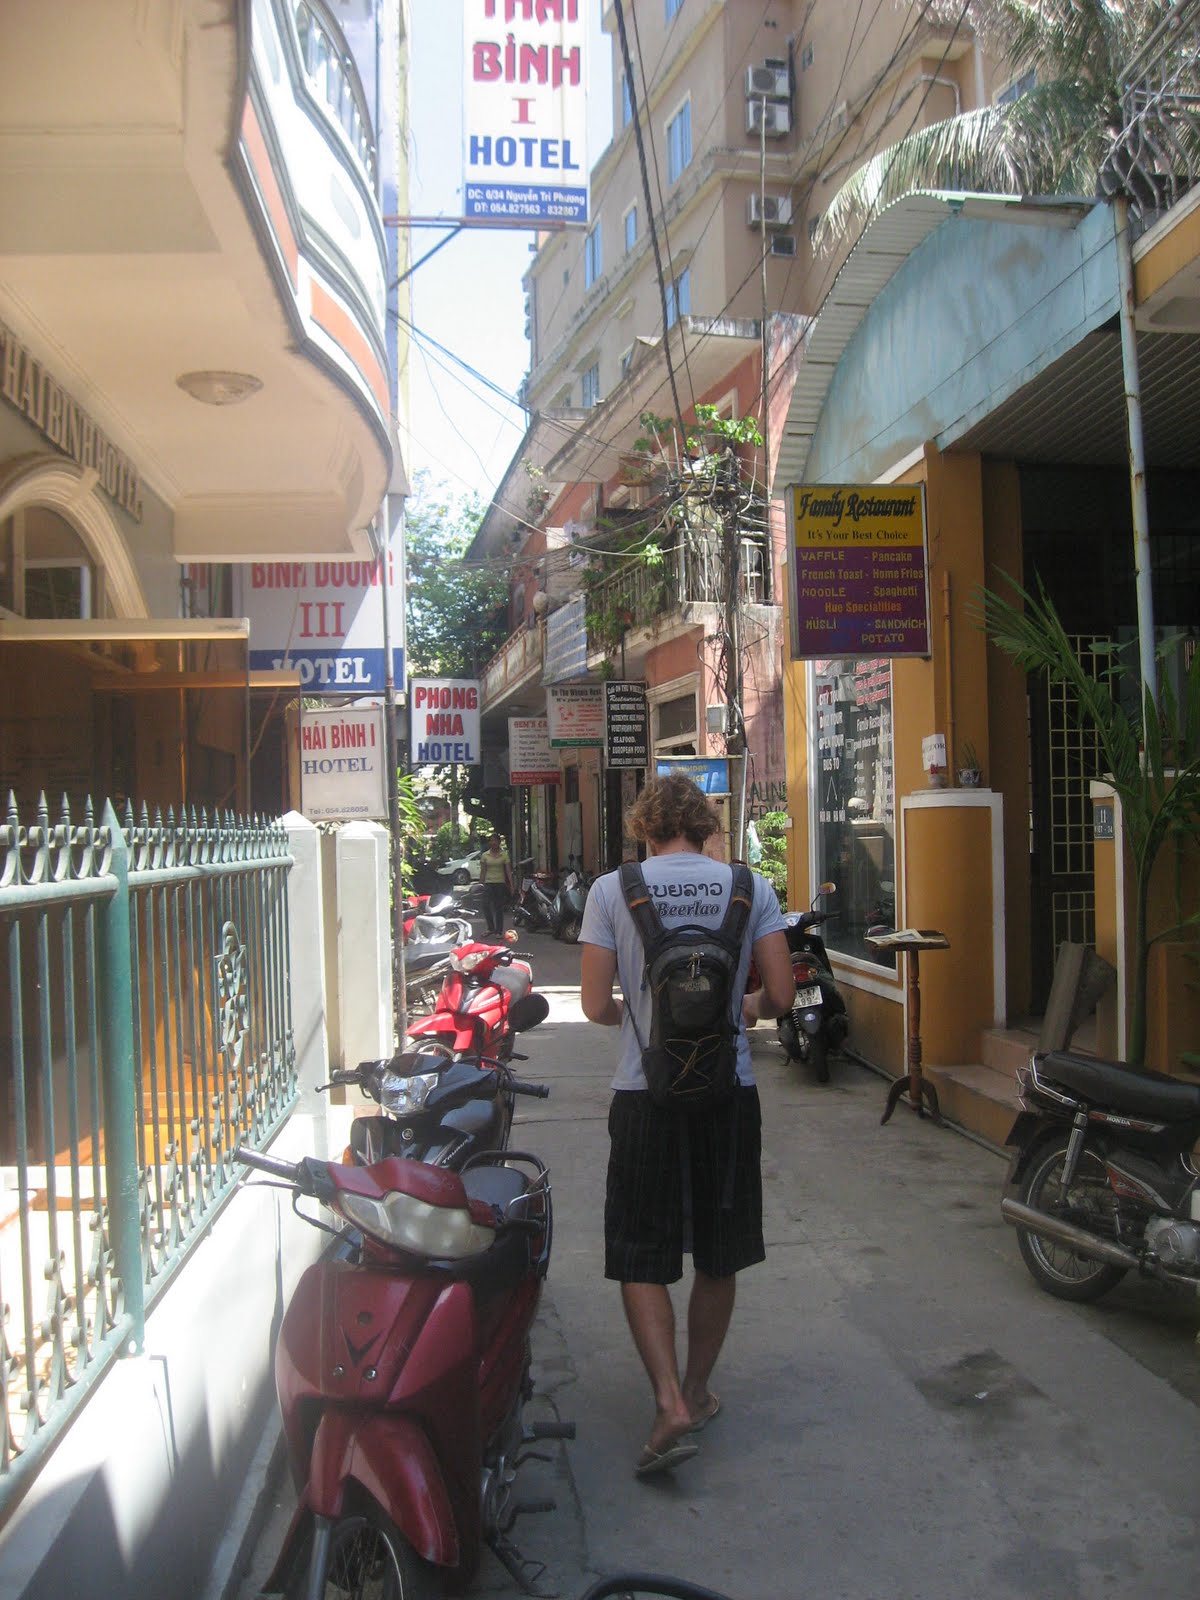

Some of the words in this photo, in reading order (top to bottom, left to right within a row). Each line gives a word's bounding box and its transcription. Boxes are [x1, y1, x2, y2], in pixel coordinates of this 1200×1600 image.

[511, 97, 536, 125] I
[469, 134, 580, 170] HOTEL
[798, 490, 845, 527] Family
[845, 493, 917, 522] Restaurant
[808, 529, 823, 540] It's
[826, 530, 849, 540] Your
[852, 530, 873, 540] Best
[876, 530, 908, 540] Choice
[801, 551, 845, 561] WAFFLE
[872, 551, 913, 562] Pancake
[801, 569, 836, 580] French
[838, 569, 863, 580] Toast
[873, 569, 898, 580] Home
[900, 569, 924, 579] Fries
[801, 587, 847, 598] NOODLE
[873, 585, 918, 598] Spaghetti
[825, 602, 843, 613] Hue
[298, 602, 346, 638] III
[861, 633, 905, 644] POTATO
[415, 686, 478, 710] PHONG
[426, 713, 465, 736] NHA
[417, 742, 475, 761] HOTEL
[634, 745, 646, 754] FOOD
[302, 757, 374, 775] HOTEL
[823, 758, 833, 771] BUS
[833, 757, 840, 770] TO
[657, 900, 720, 917] Beerlao
[1106, 1116, 1131, 1126] HONDA
